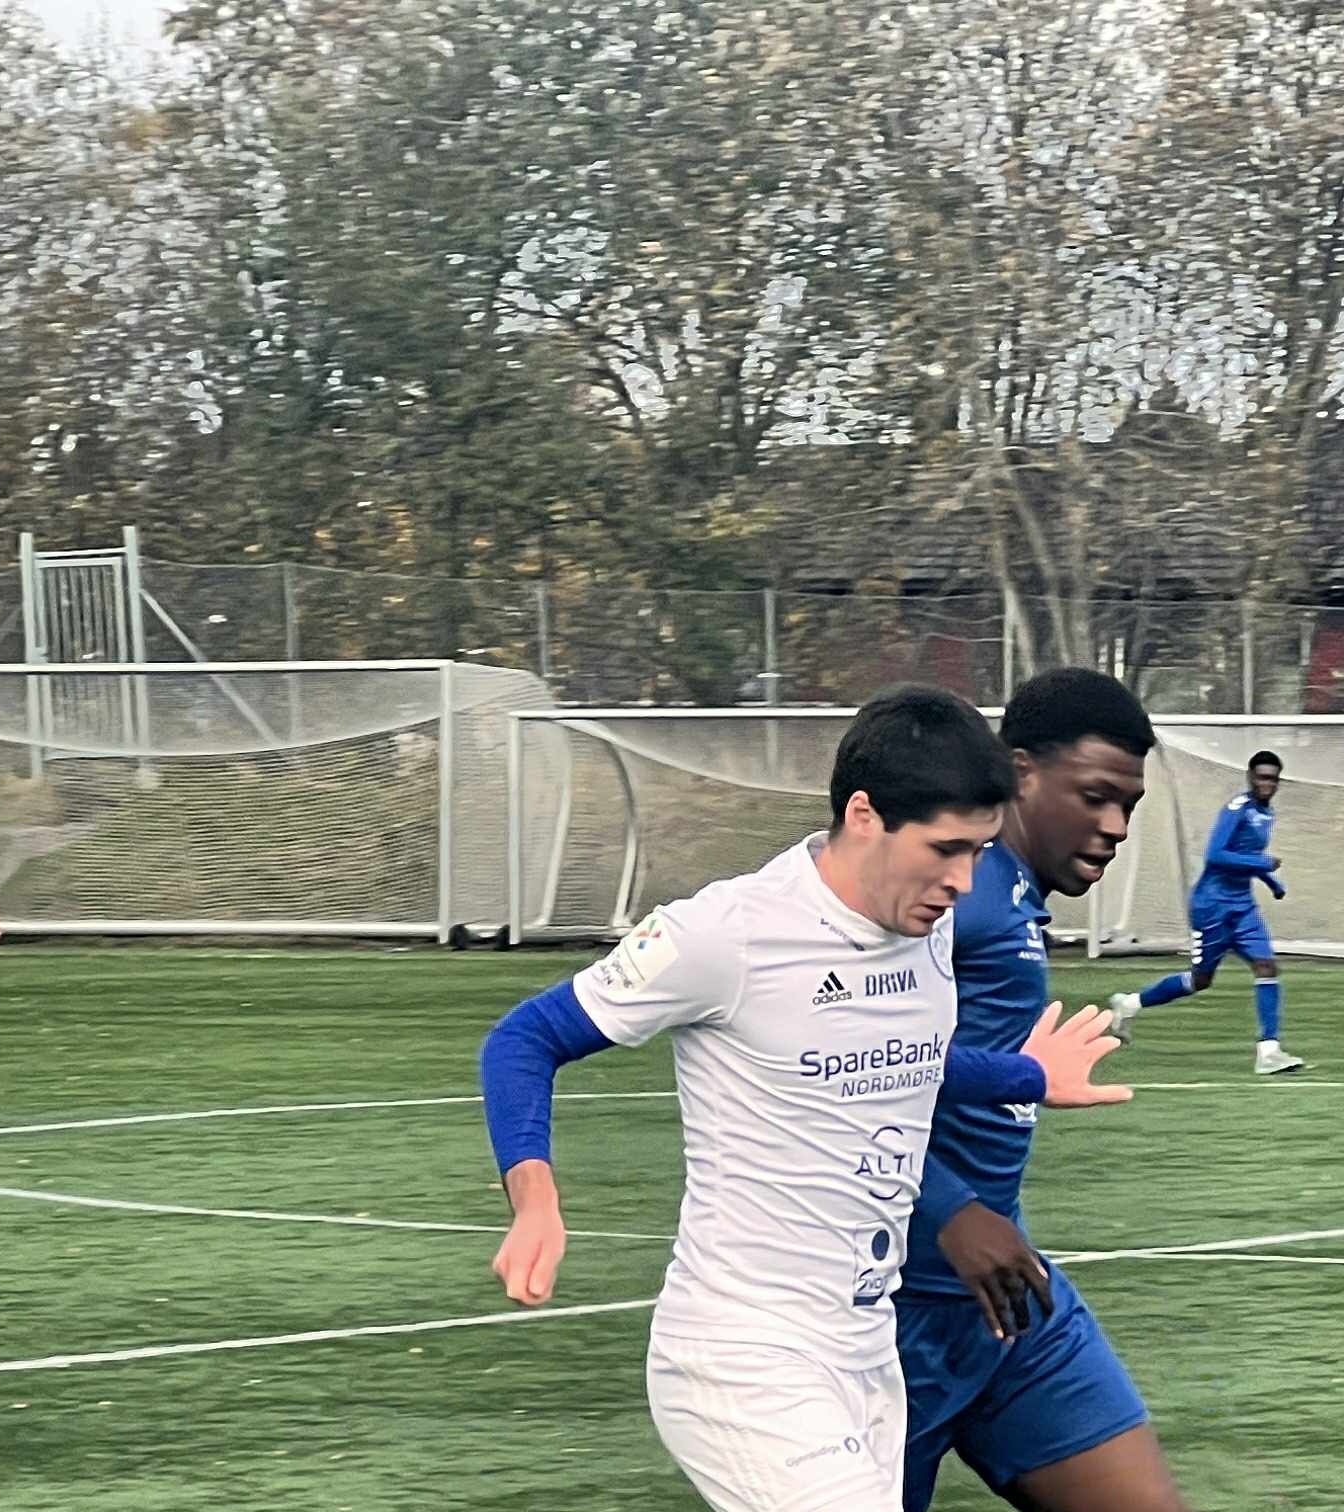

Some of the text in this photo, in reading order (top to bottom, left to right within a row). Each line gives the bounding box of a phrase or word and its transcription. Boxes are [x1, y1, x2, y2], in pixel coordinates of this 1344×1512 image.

[812, 991, 852, 1005] adidas
[799, 1033, 943, 1081] SpareBank
[841, 1067, 941, 1097] NORDMØRE
[855, 1152, 914, 1175] ALTI
